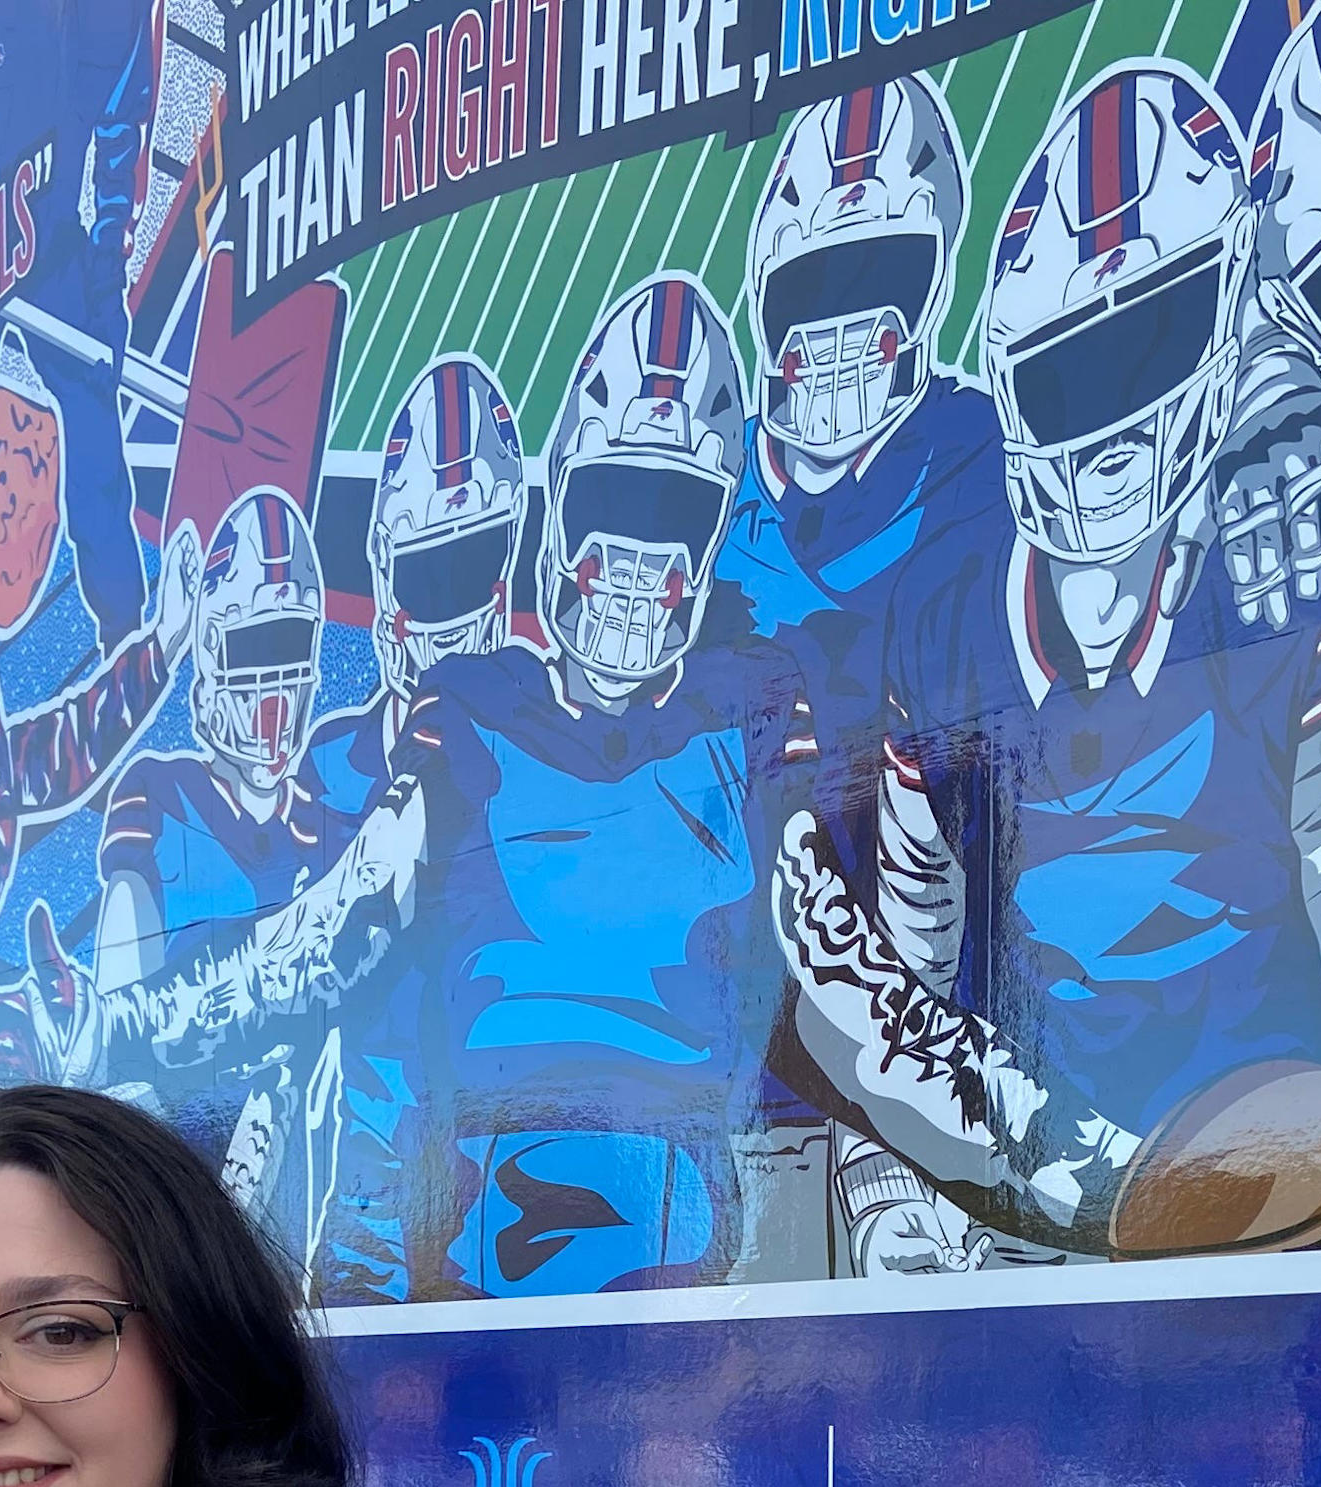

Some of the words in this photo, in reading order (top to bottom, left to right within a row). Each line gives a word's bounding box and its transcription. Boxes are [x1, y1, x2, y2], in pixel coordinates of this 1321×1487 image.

[240, 89, 365, 297] THAN
[381, 0, 566, 212] RIGHT
[579, 0, 770, 136] HERE,
